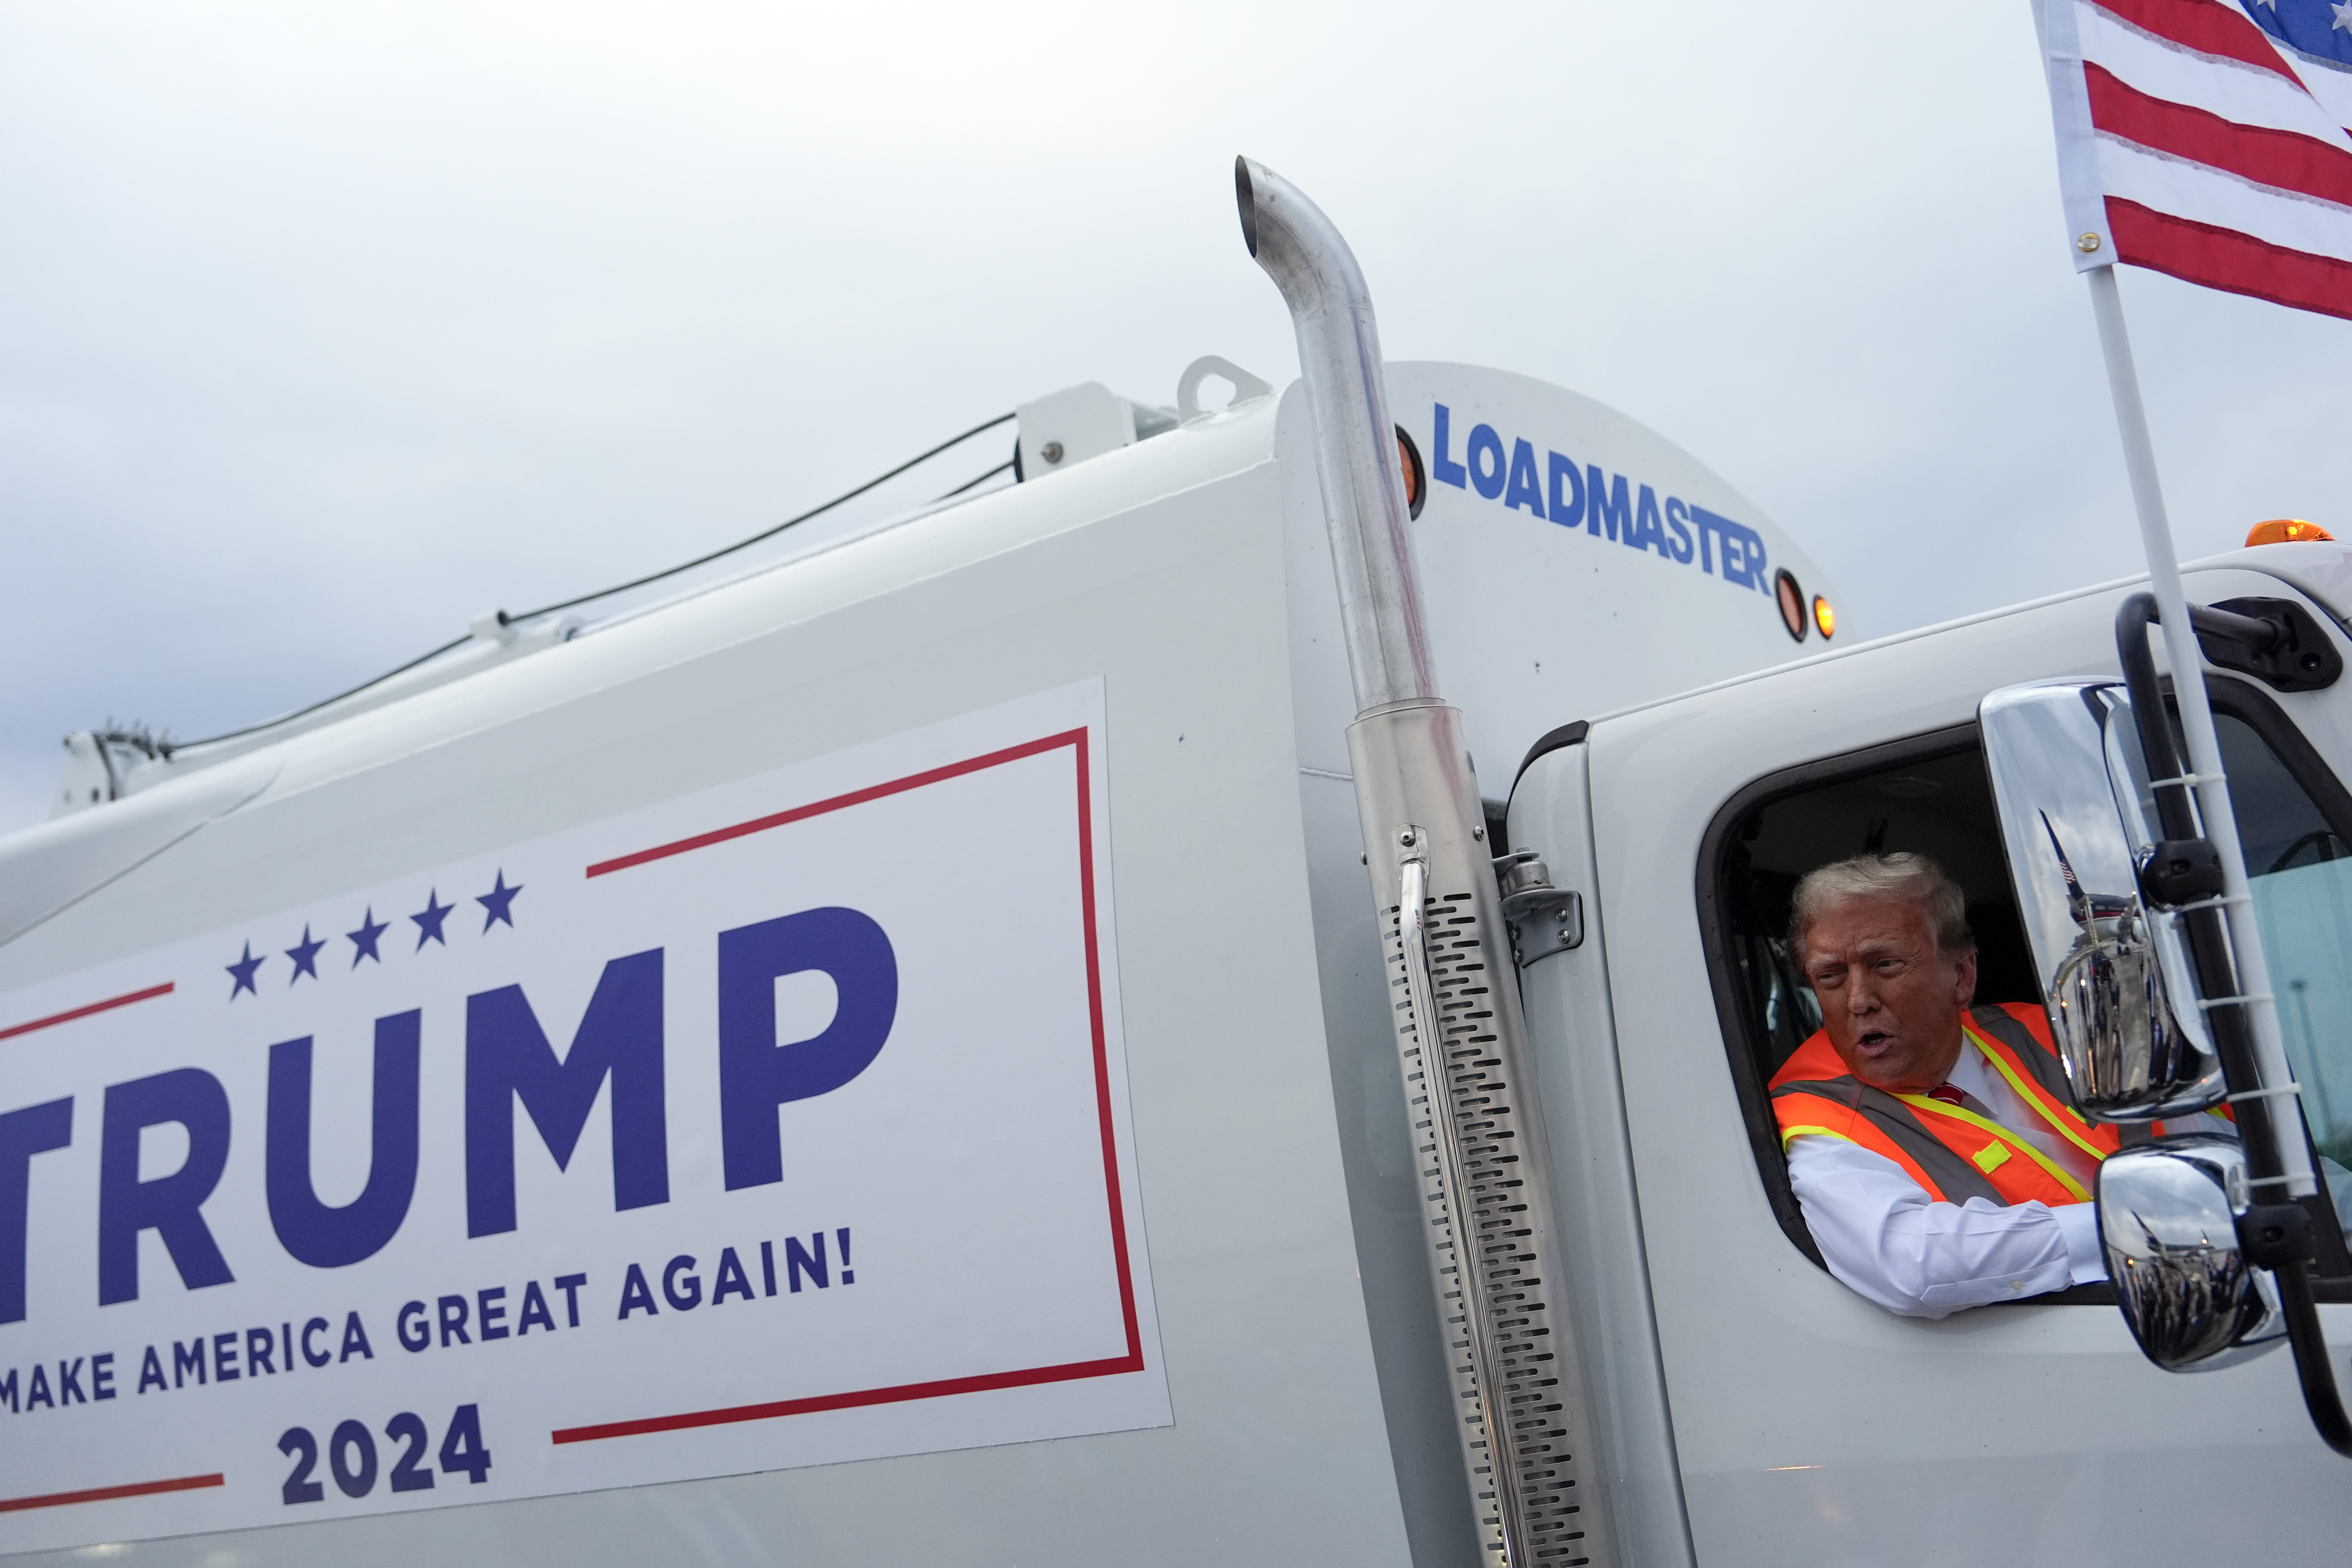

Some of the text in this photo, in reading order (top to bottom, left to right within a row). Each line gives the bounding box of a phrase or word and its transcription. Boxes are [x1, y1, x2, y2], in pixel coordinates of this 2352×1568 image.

[1433, 402, 1771, 596] LOADMASTER
[0, 906, 899, 1327] TRUMP
[0, 1227, 856, 1414] MAKE AMERICA GREAT AGAIN!
[278, 1403, 492, 1503] 2024
